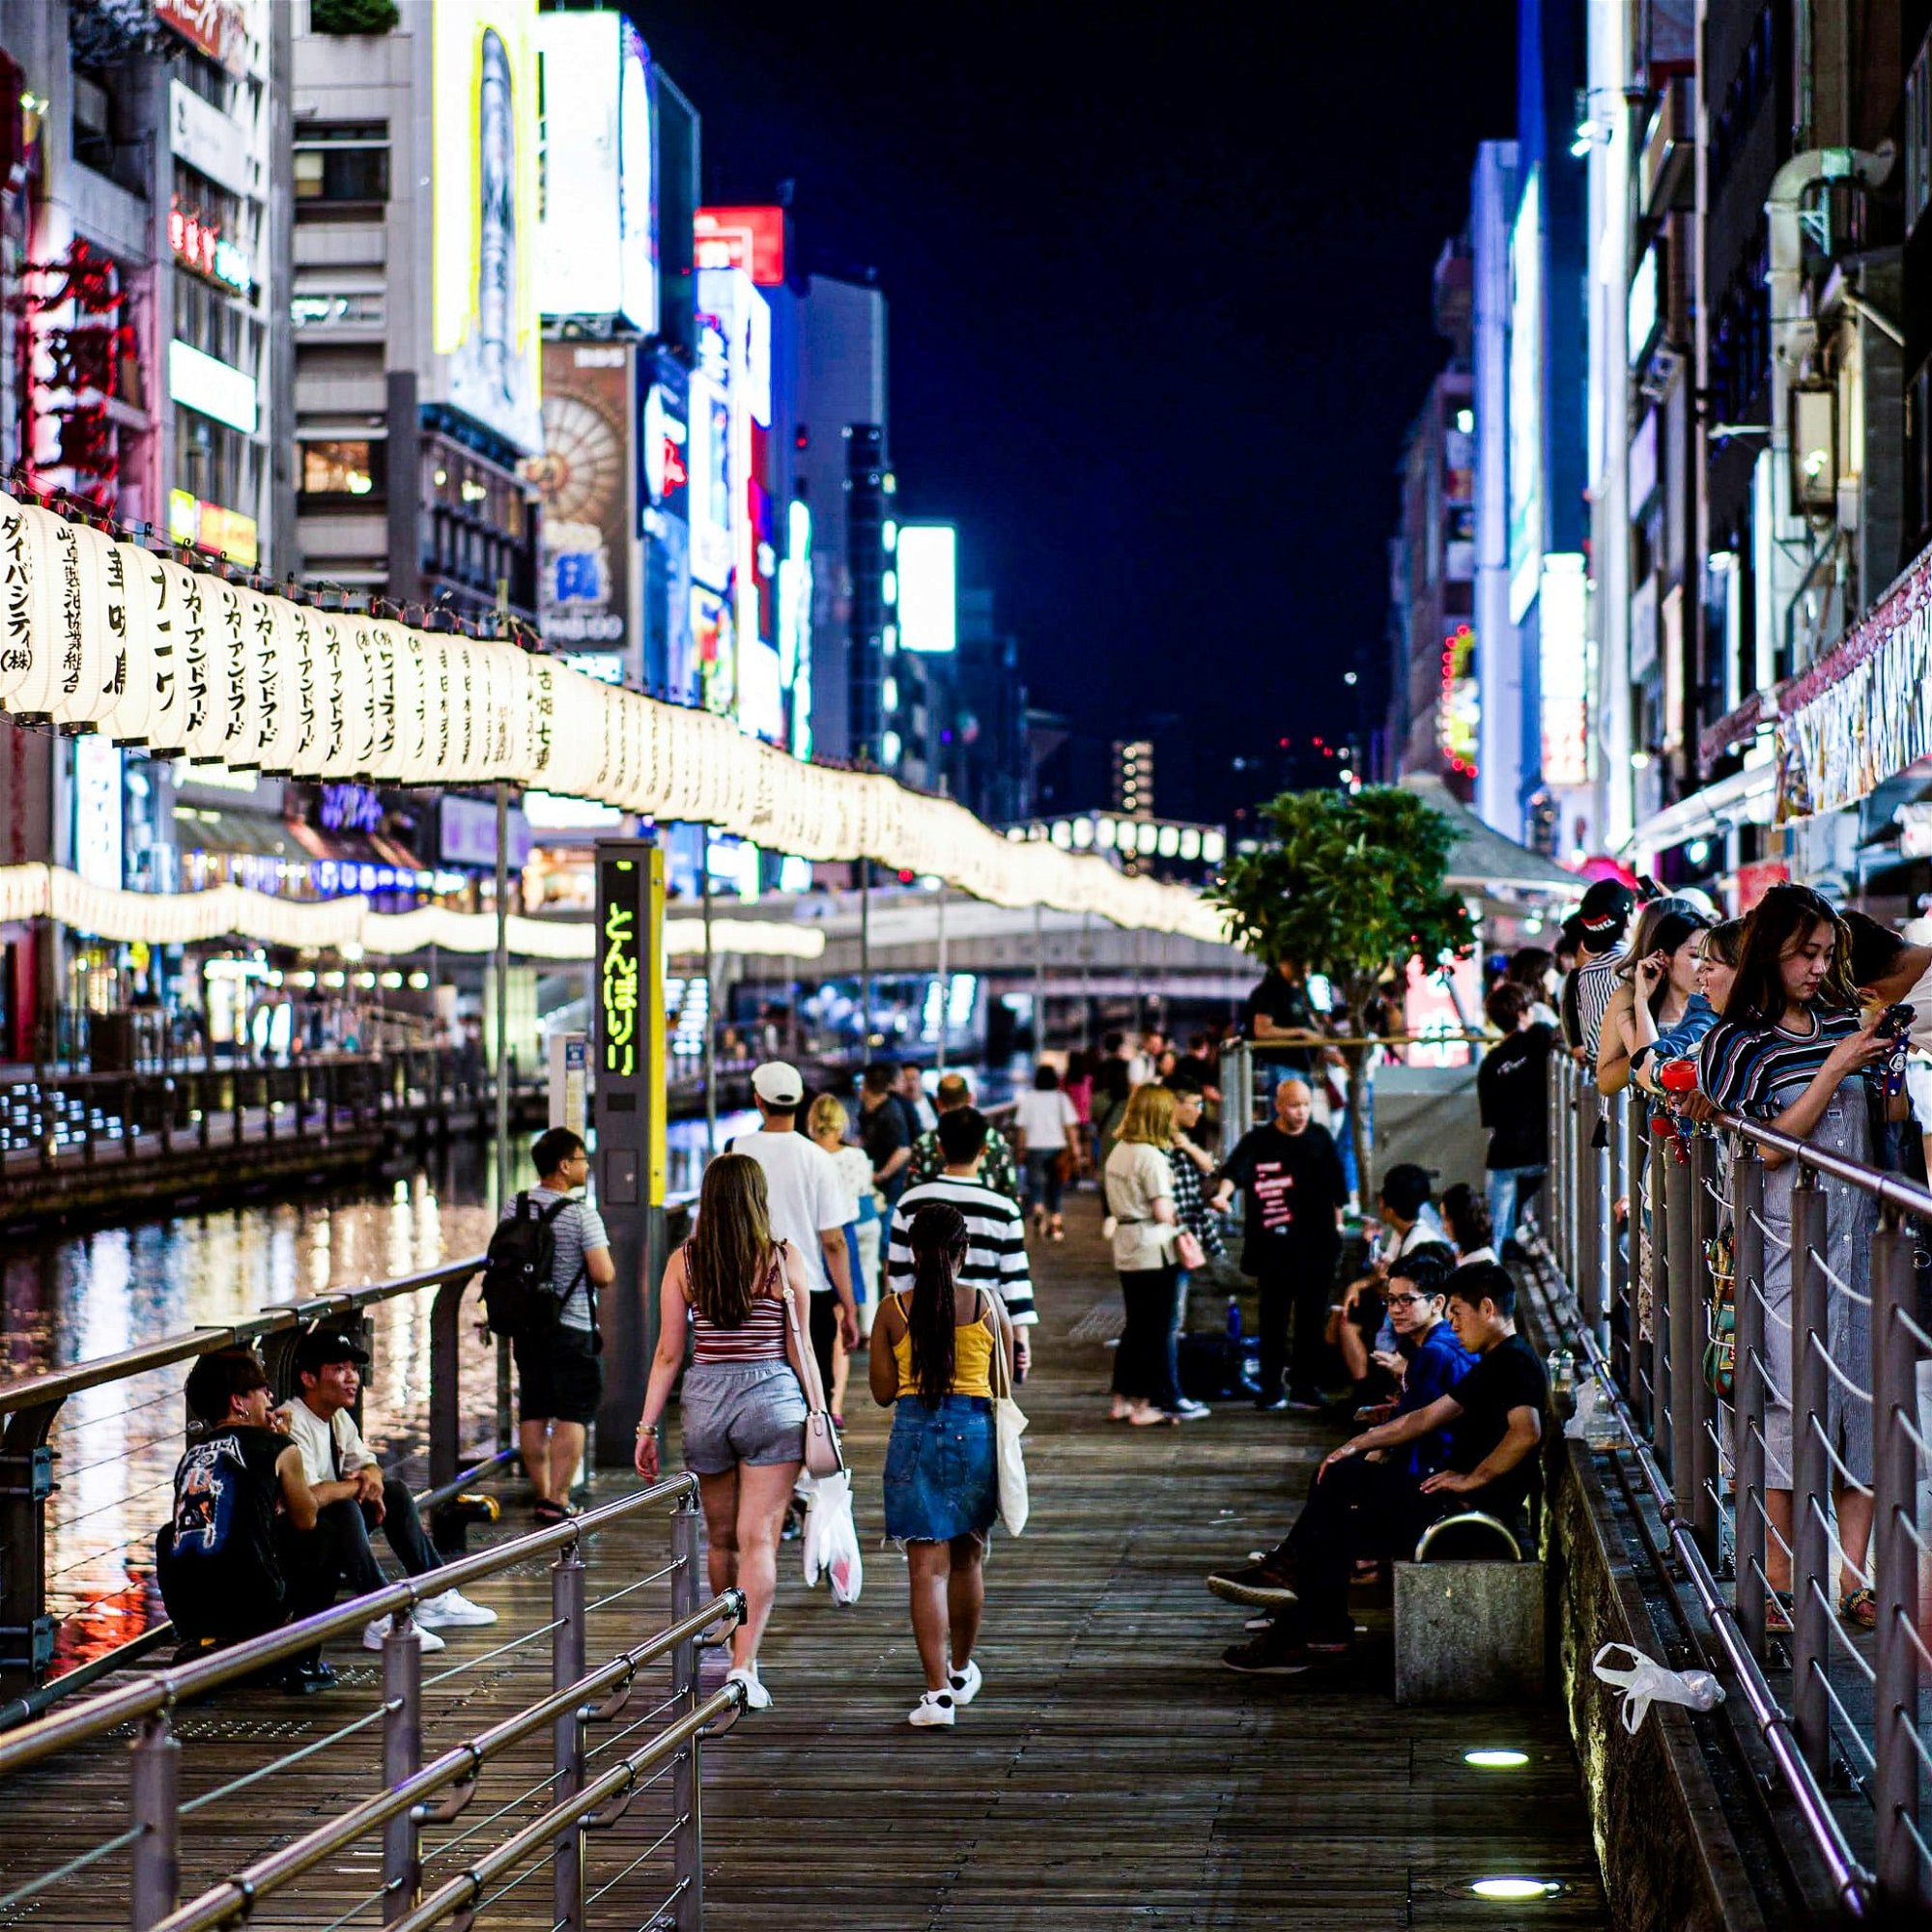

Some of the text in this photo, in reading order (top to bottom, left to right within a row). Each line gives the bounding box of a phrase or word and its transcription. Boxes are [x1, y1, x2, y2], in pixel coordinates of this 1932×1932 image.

[183, 576, 208, 732] リカーアンドフード
[223, 591, 246, 740] リカーアンドフード
[253, 602, 278, 748] リカーアンドフード
[295, 611, 315, 753] リカーアンドフード
[326, 623, 344, 762] リカーアンドフード
